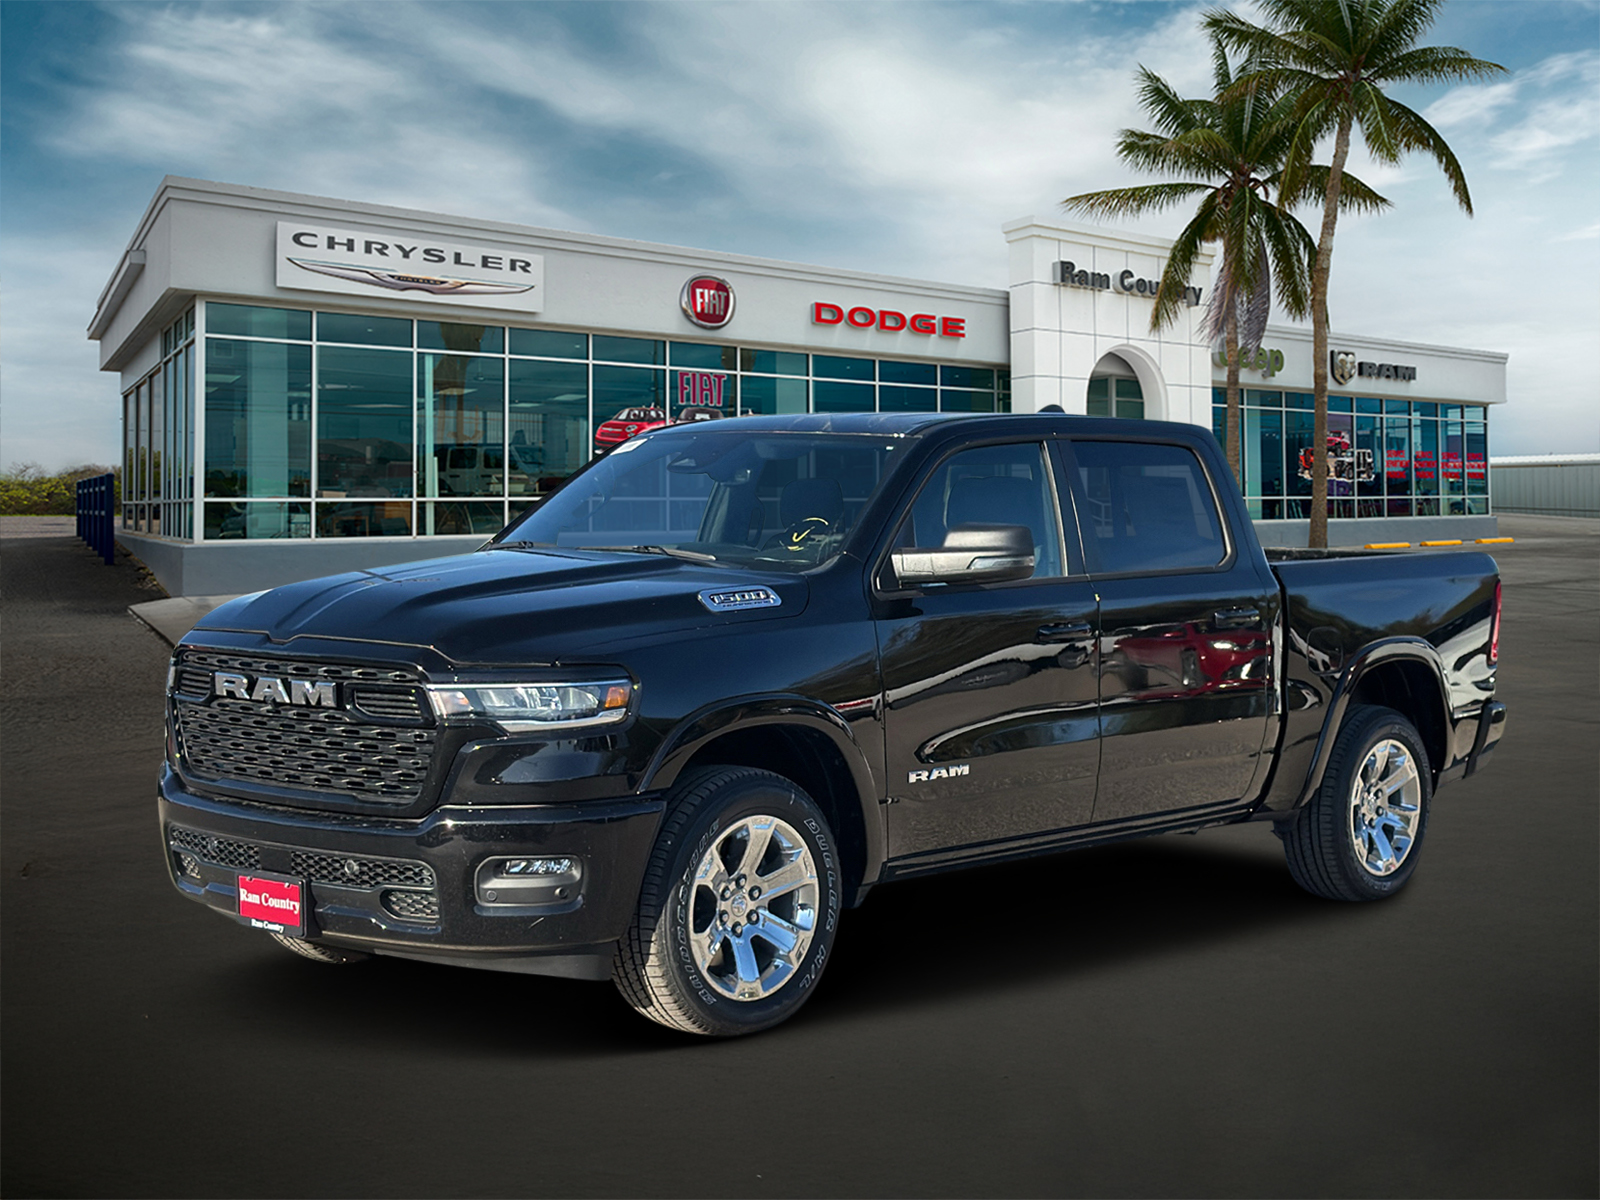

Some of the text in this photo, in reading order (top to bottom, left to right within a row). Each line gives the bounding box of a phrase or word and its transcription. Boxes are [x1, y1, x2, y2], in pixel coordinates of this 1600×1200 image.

[292, 232, 533, 273] CHRYSLER
[1059, 260, 1203, 307] Ram Coury
[696, 288, 727, 316] FIAT
[813, 301, 966, 338] DODGE
[678, 371, 727, 406] FIAT
[1361, 362, 1416, 381] RAM
[710, 590, 767, 604] 1500
[215, 672, 337, 707] RAM
[908, 764, 970, 783] RAM
[804, 818, 839, 932] DUELER
[240, 887, 300, 915] Ram Country
[677, 818, 720, 1005] BRIDGESTONE
[251, 918, 263, 929] Ram
